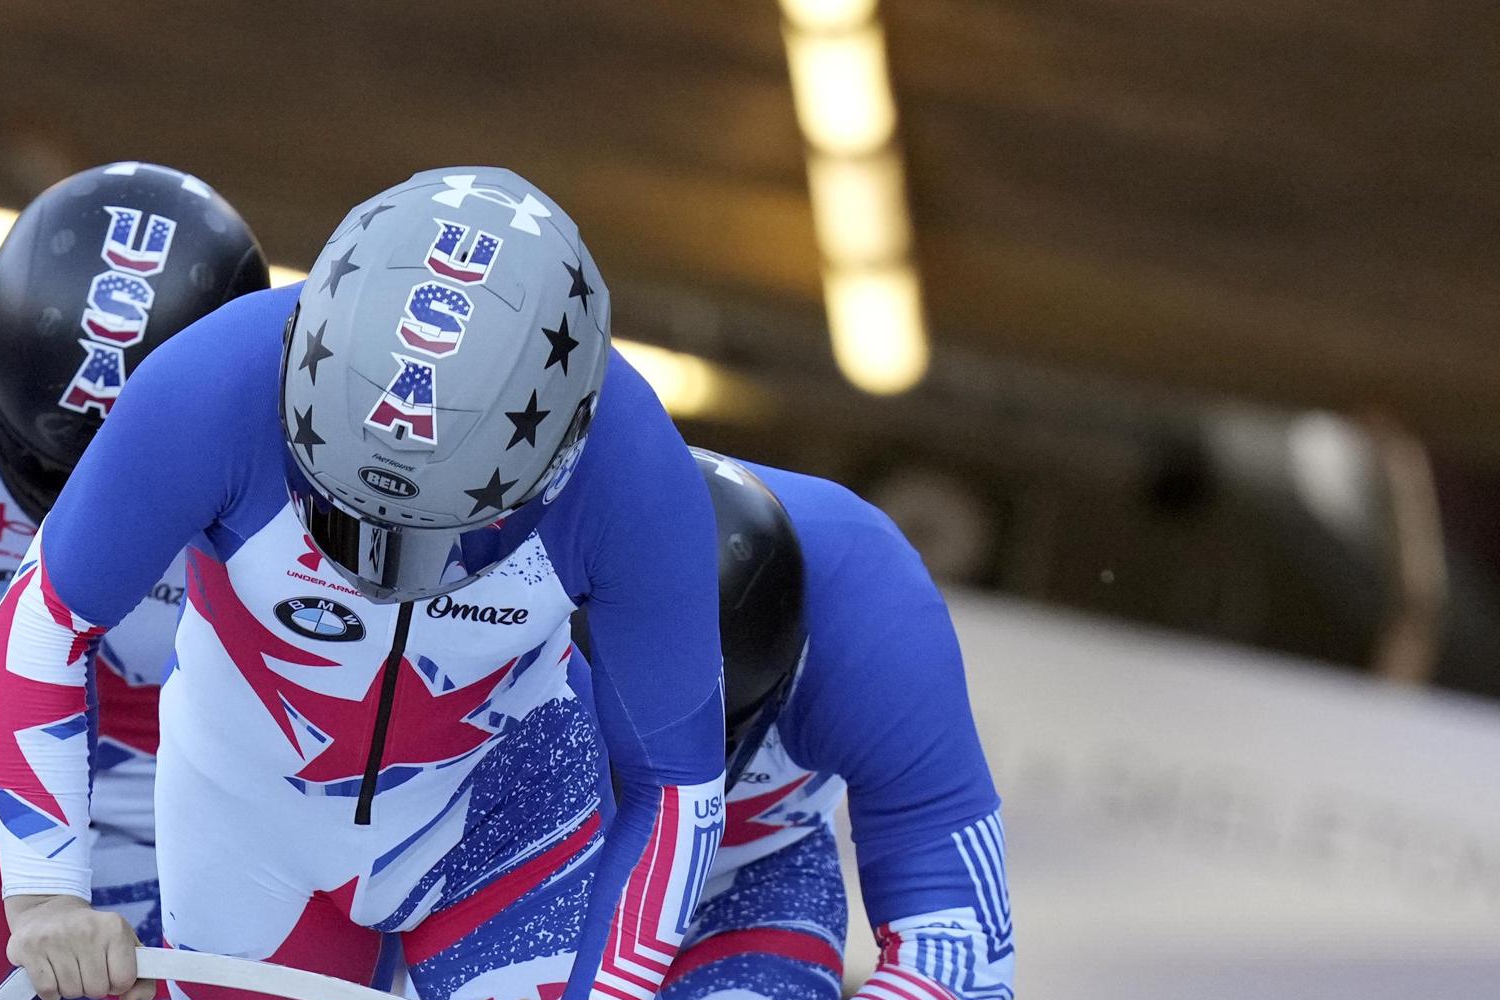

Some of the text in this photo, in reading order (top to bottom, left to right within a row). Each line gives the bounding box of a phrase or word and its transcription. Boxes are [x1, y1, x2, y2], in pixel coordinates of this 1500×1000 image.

[57, 205, 178, 420] USA
[363, 218, 504, 446] USA
[366, 470, 410, 497] BELL
[286, 569, 364, 598] UNDER ARMO
[287, 599, 361, 627] BMW
[426, 594, 529, 625] Omaze
